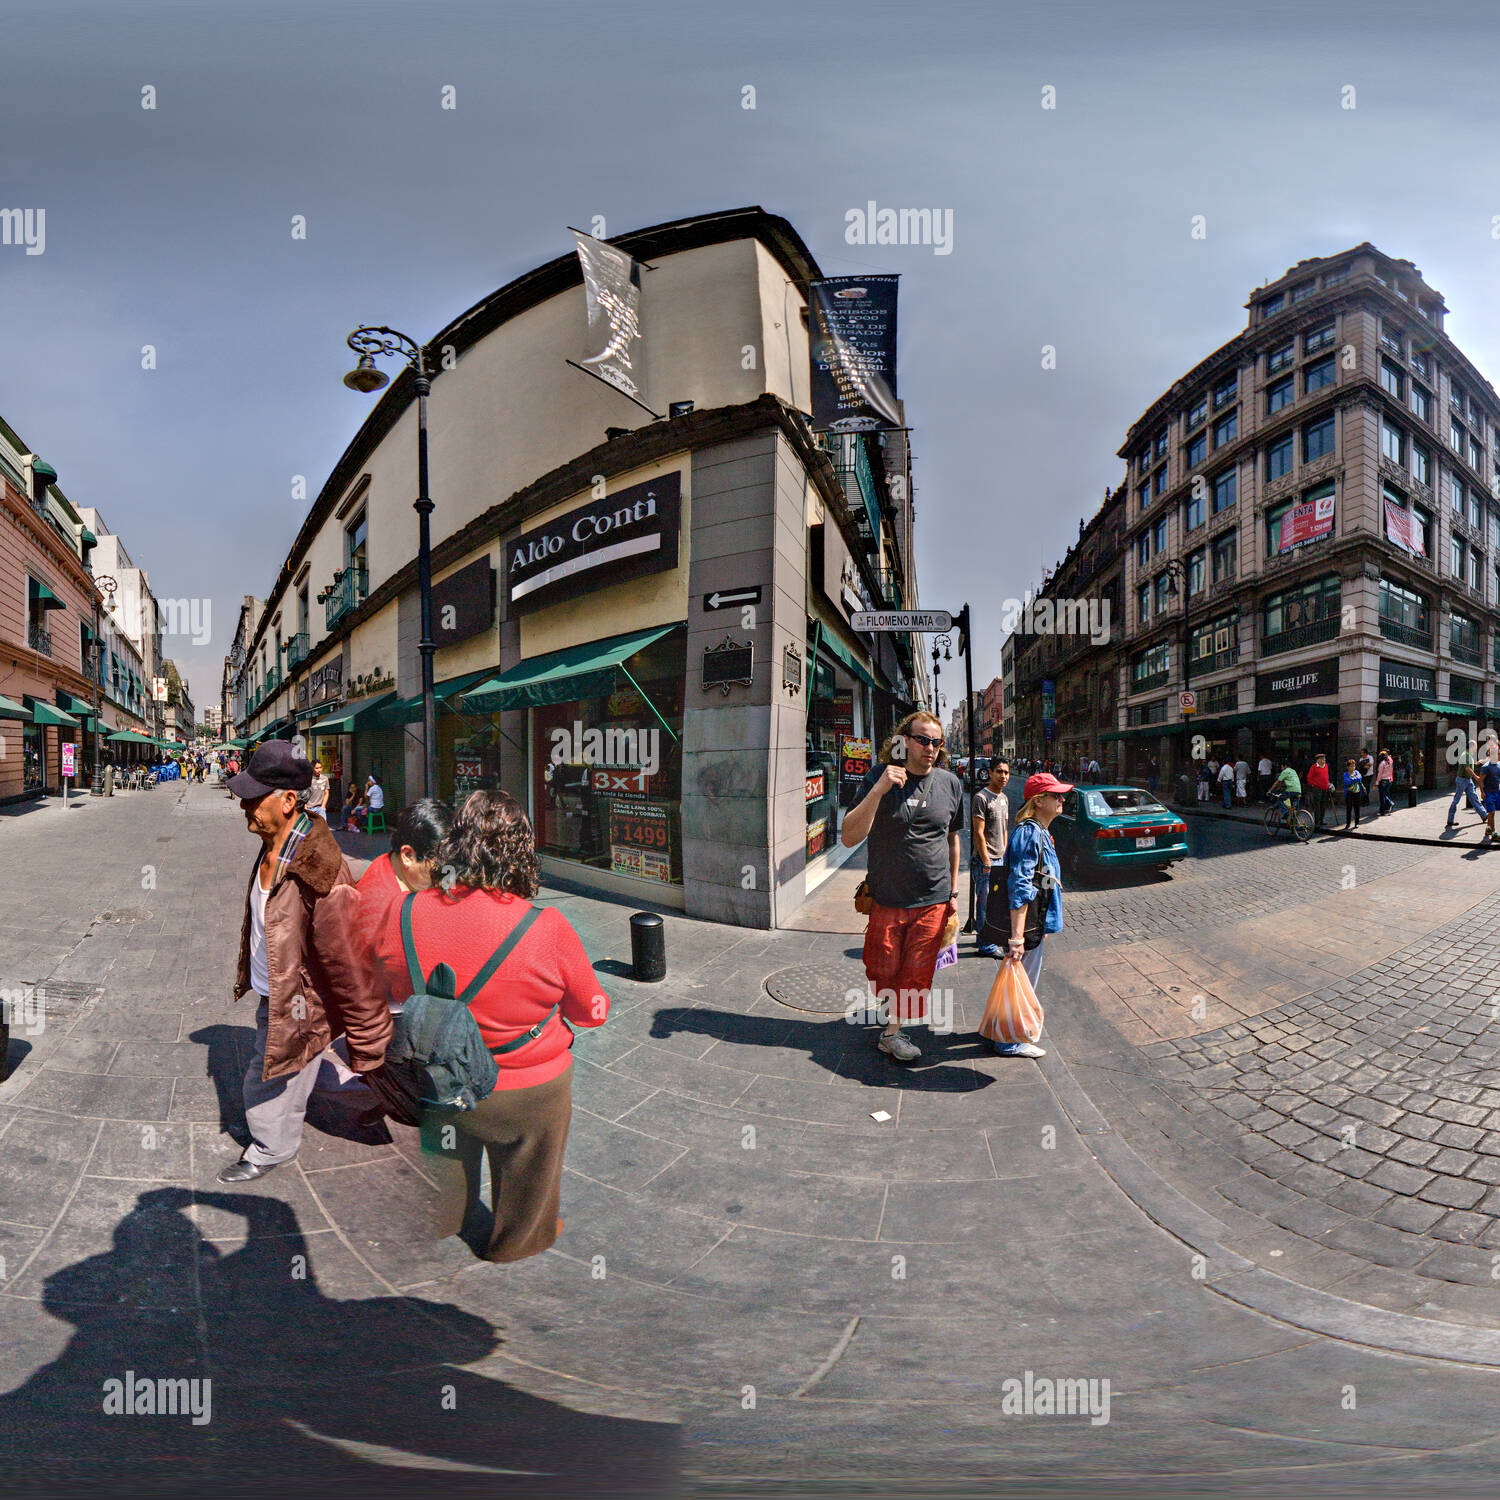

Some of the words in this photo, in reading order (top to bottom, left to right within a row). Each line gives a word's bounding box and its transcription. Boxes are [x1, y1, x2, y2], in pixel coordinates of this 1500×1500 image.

[510, 535, 566, 573] Aldo
[866, 615, 909, 627] FILOMENO
[911, 615, 934, 627] MATA
[1271, 677, 1295, 691] HIGH
[1296, 672, 1319, 687] LIFE
[1385, 673, 1409, 689] HIGH
[1411, 678, 1430, 692] LIFE
[456, 763, 482, 776] 3x1
[594, 772, 645, 791] 3x1
[805, 777, 824, 798] 3x1
[623, 824, 667, 847] 1499
